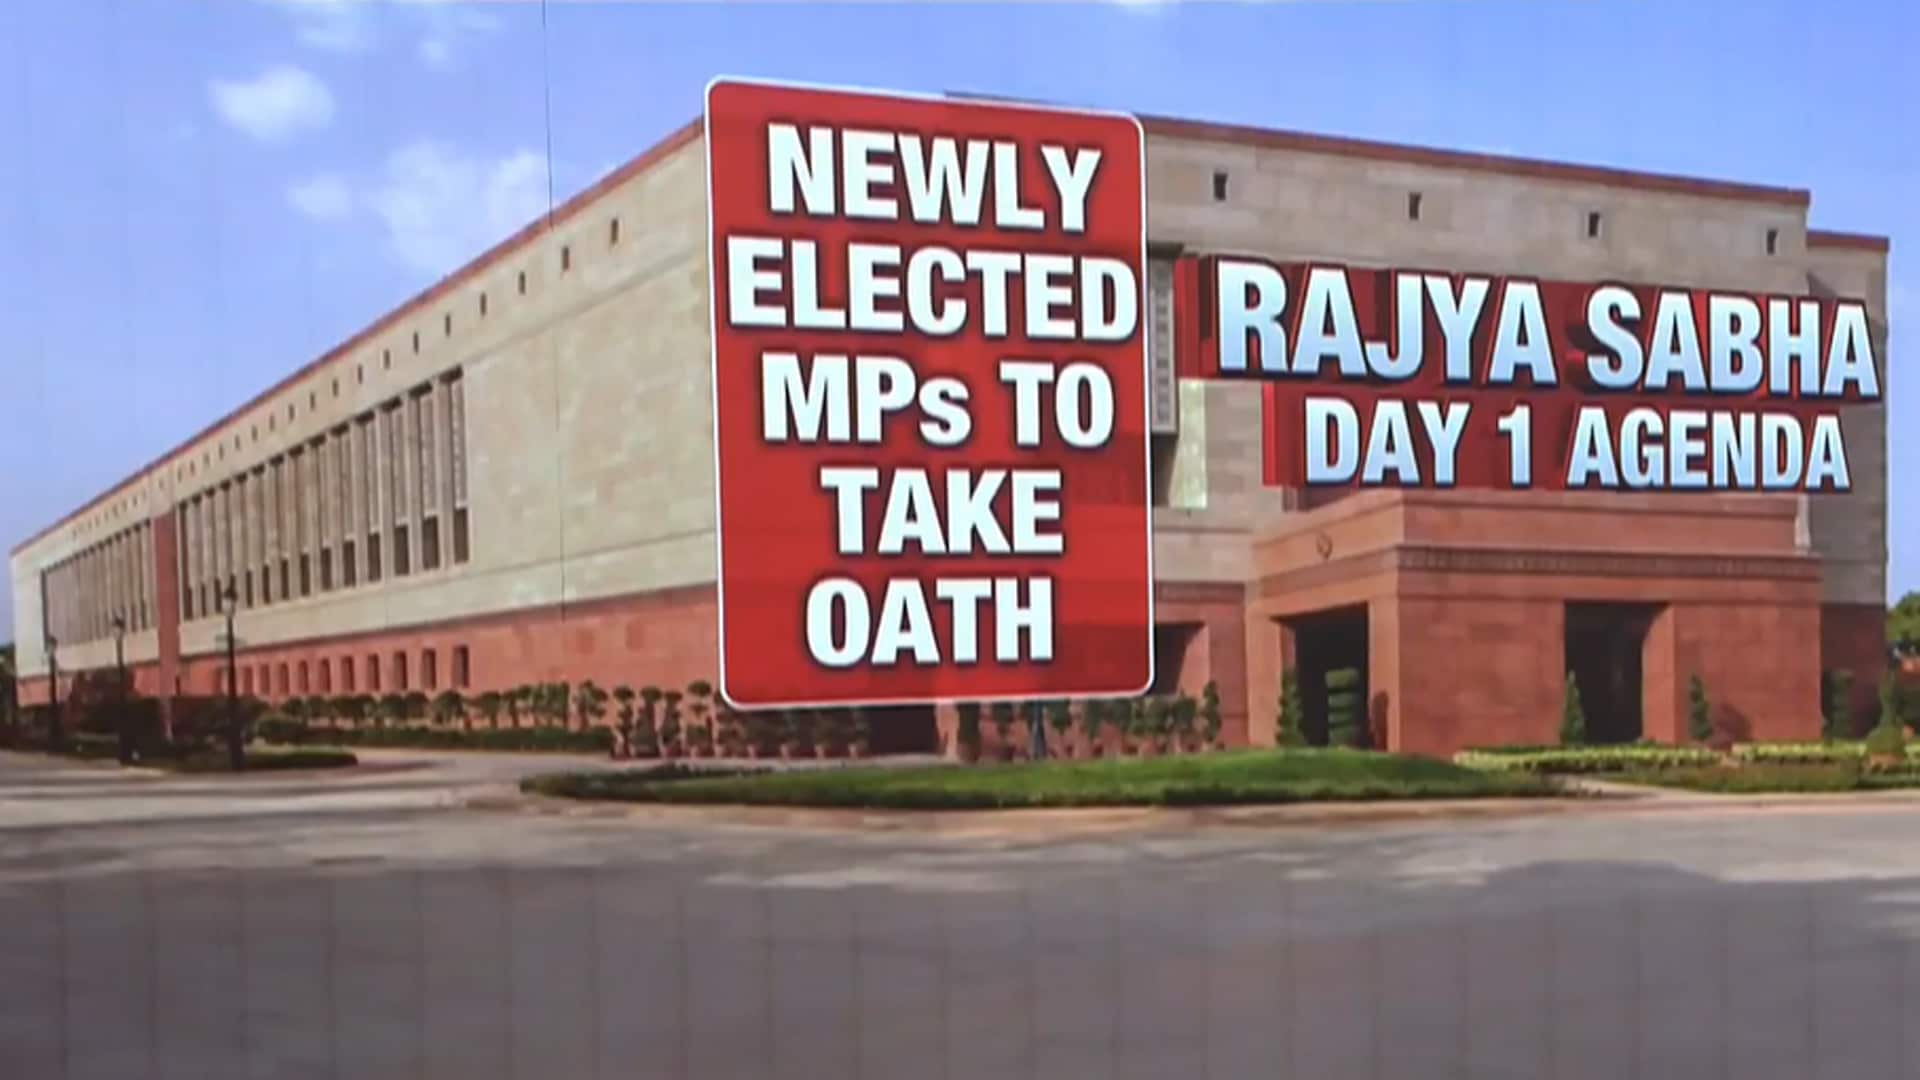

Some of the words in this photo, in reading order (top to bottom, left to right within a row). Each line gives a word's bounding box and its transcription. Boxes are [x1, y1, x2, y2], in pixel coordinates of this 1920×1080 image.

[767, 122, 1102, 233] NEWLY
[726, 235, 1139, 342] ELECTED
[1216, 259, 1557, 384] RAJYA
[1586, 286, 1880, 397] SABHA
[762, 351, 972, 447] MPs
[1000, 361, 1114, 449] TO
[1304, 396, 1470, 486] DAY
[1498, 404, 1532, 486] 1
[1566, 406, 1851, 489] AGENDA
[820, 467, 1064, 554] TAKE
[805, 576, 1053, 666] OATH
